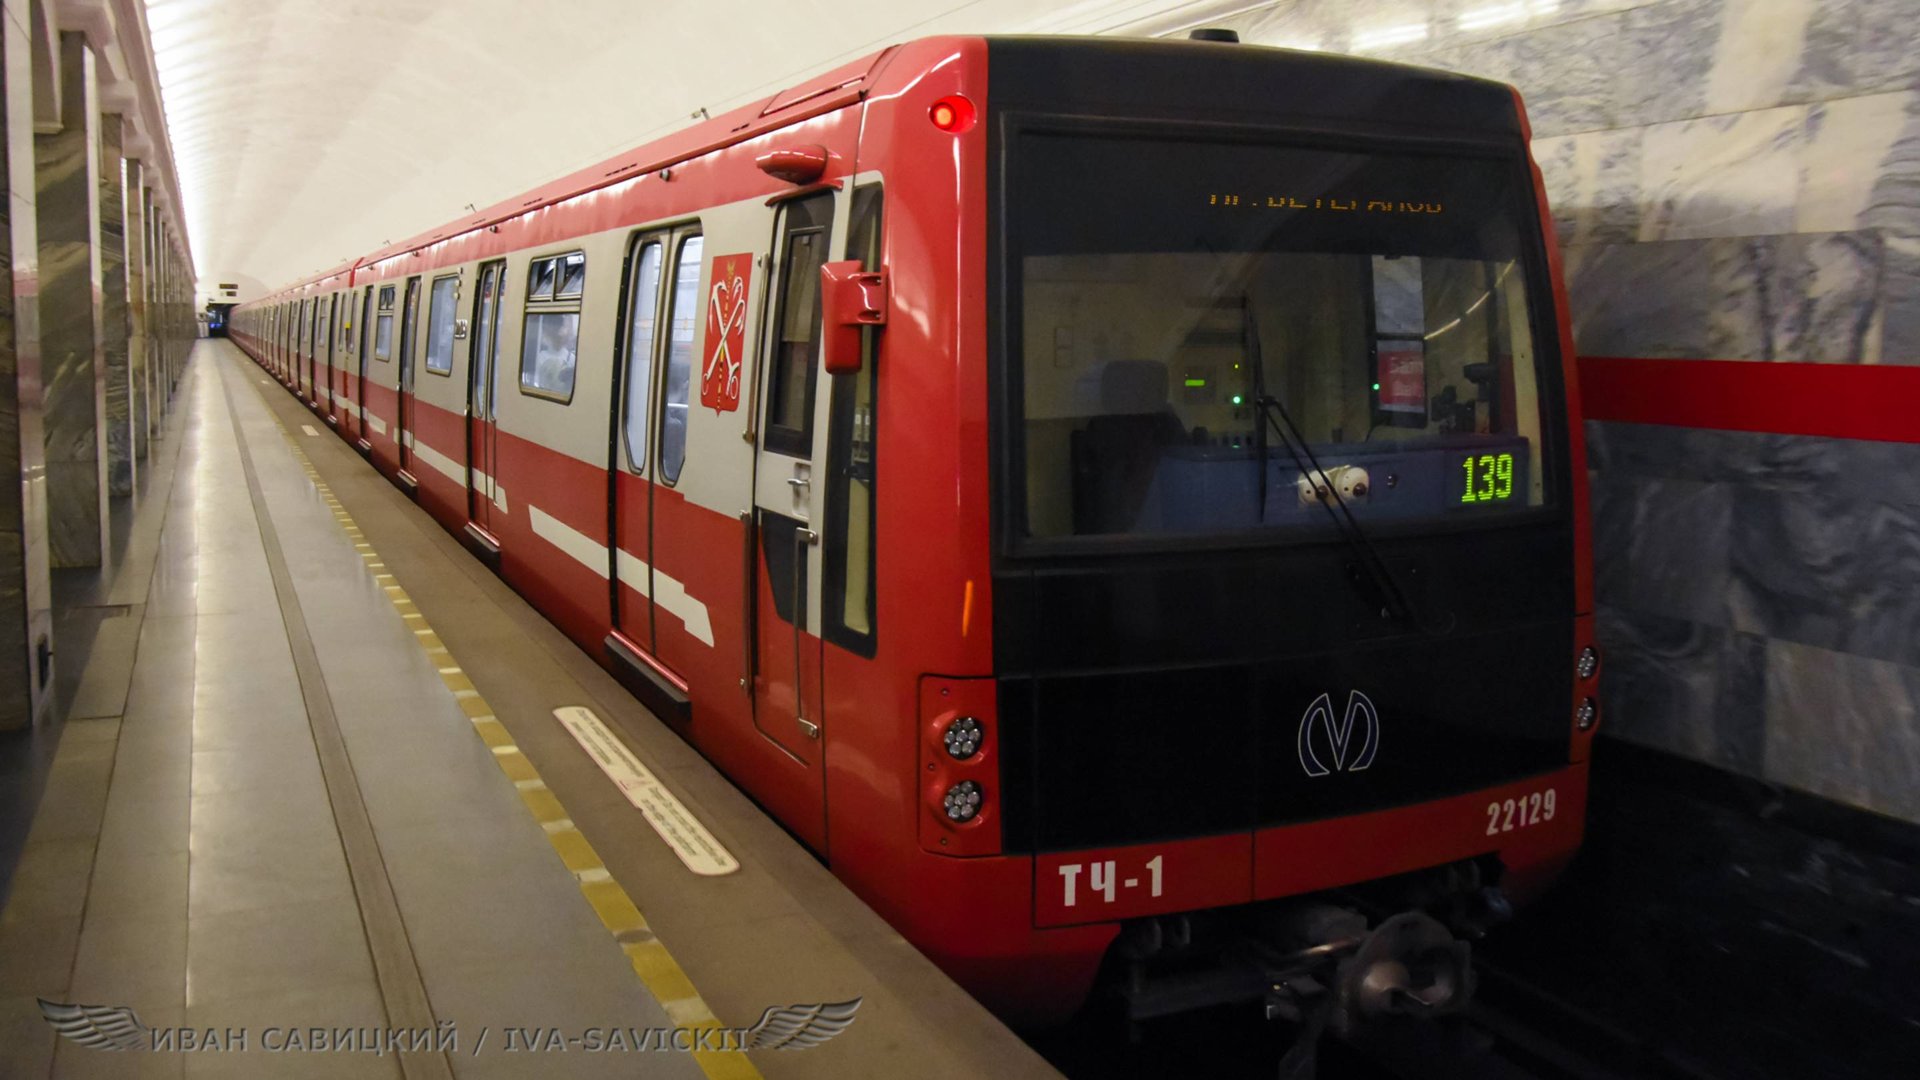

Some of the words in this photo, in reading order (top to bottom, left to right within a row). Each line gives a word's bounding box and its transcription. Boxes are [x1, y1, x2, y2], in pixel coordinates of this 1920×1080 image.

[1461, 454, 1514, 503] 139
[1486, 788, 1557, 836] 22129
[1058, 855, 1164, 907] ТЧ-1
